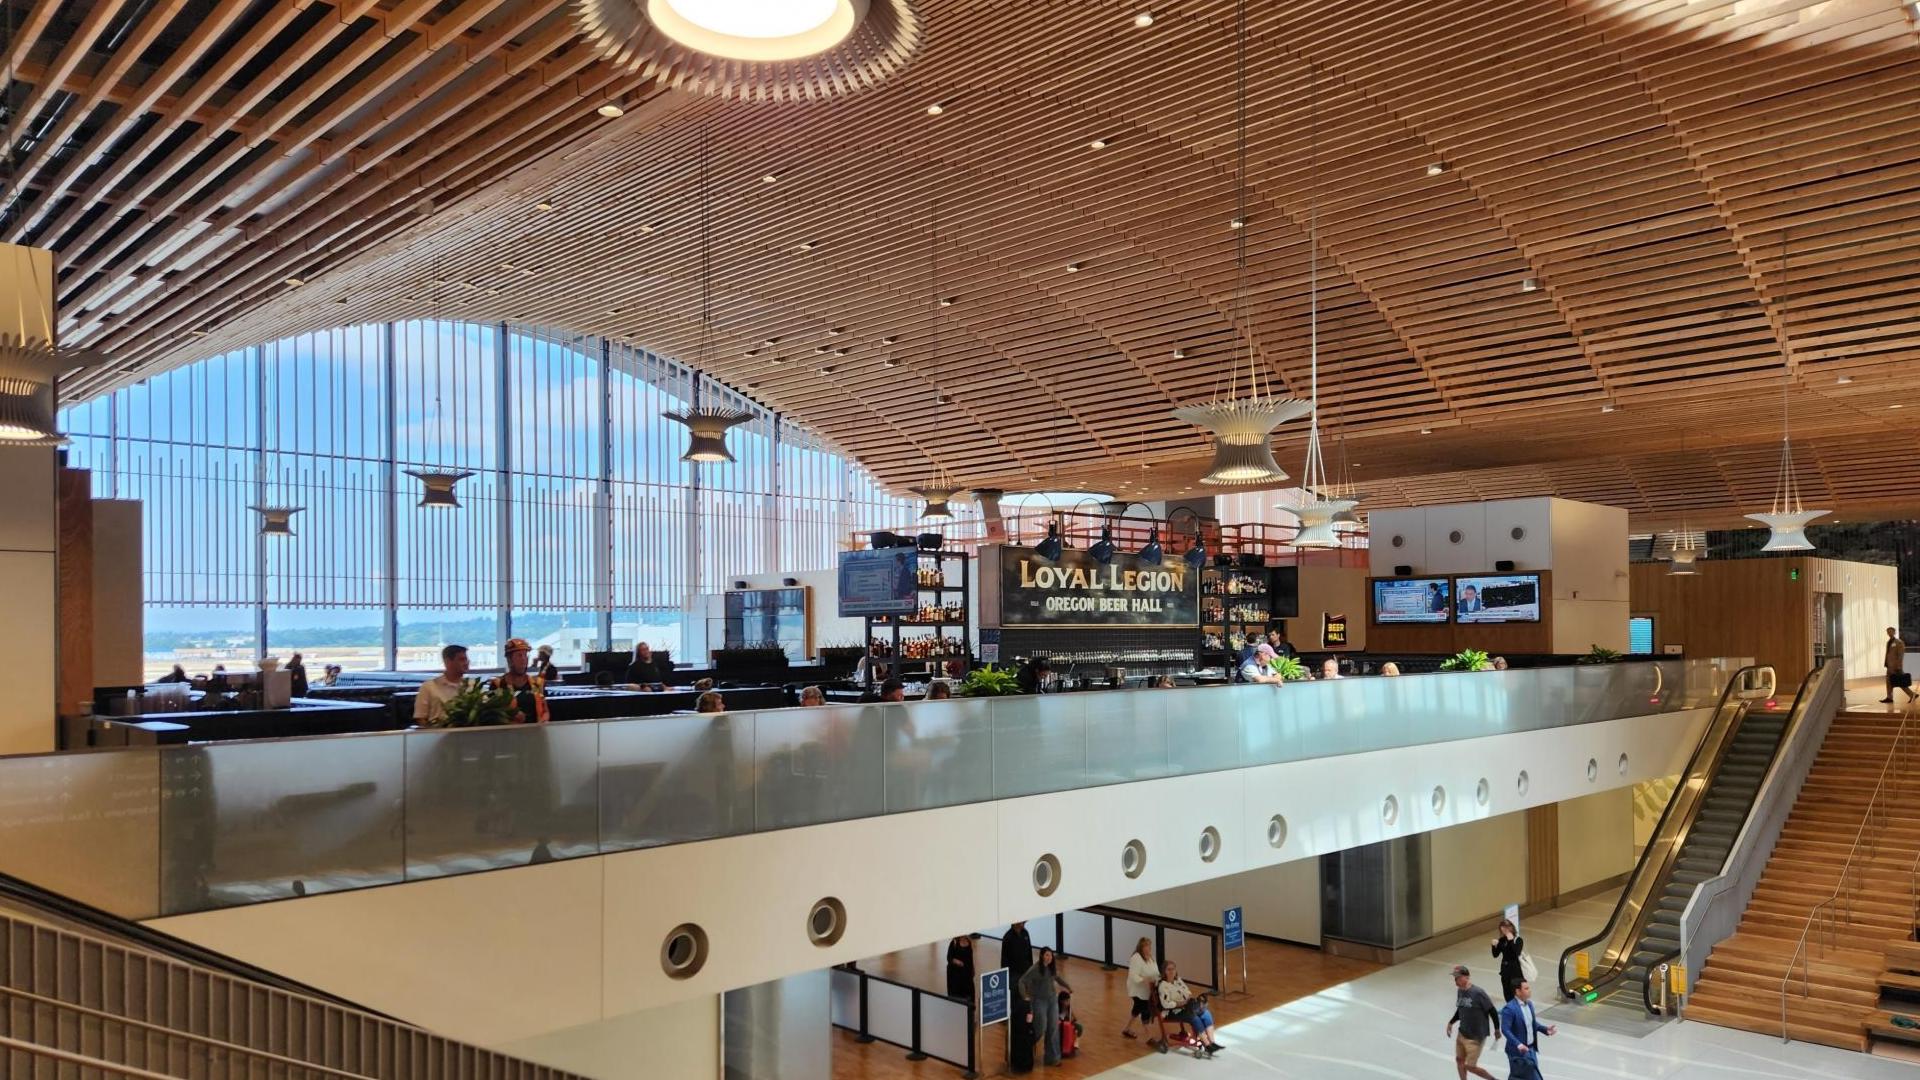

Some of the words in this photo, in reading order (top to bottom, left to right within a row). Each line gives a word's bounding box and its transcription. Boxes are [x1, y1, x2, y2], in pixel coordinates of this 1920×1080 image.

[1020, 560, 1104, 590] LOYAL
[1109, 563, 1184, 592] LEGION
[1045, 596, 1095, 612] OREGON
[1099, 597, 1128, 612] BEER
[1131, 598, 1163, 612] HALL
[1328, 623, 1344, 632] BEER
[1328, 633, 1344, 641] HALL
